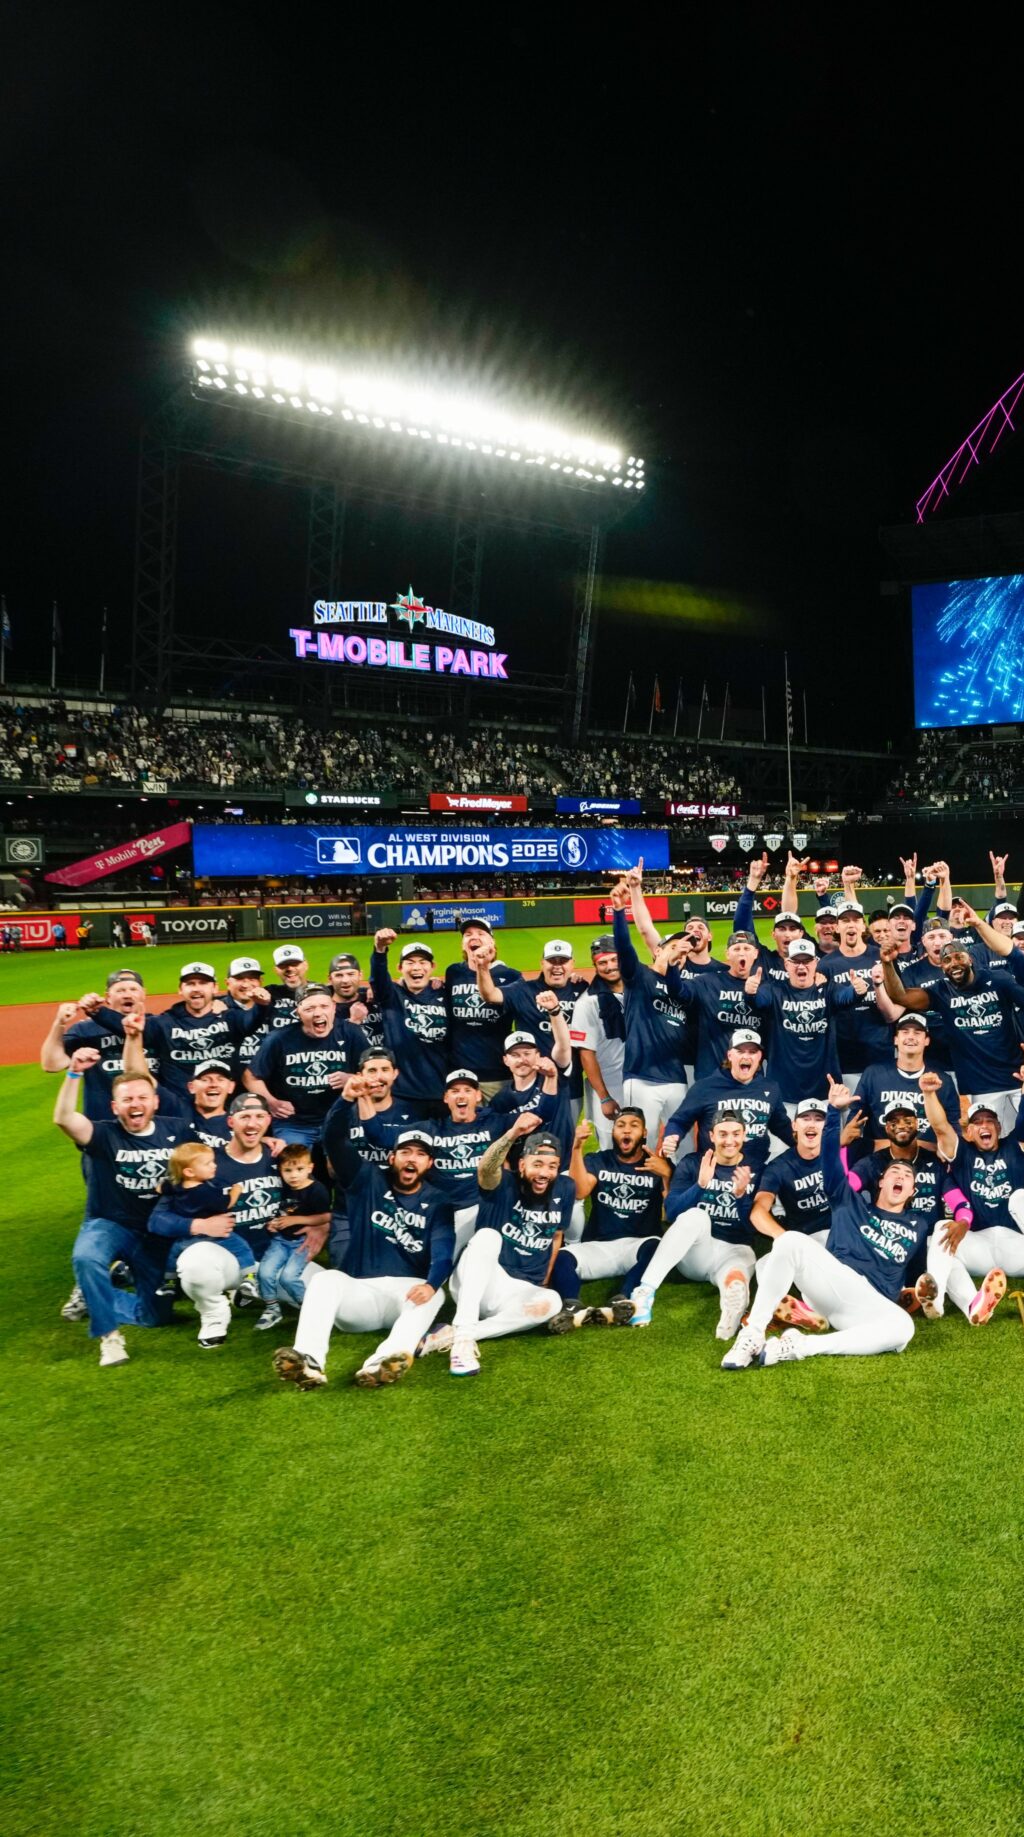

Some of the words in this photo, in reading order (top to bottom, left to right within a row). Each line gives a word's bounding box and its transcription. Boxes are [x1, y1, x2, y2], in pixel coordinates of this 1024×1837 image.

[314, 600, 387, 624] SEATTLE
[426, 606, 495, 646] MARINERS
[289, 629, 431, 671] T-MOBILE
[436, 646, 508, 678] PARK
[146, 783, 165, 792] WIN
[321, 796, 380, 804] STARBUCKS
[388, 834, 402, 842] AL
[405, 834, 437, 842] WEST
[441, 834, 489, 842] DIVISION
[368, 843, 509, 868] CHAMPIONS
[512, 844, 557, 856] 2025
[706, 901, 761, 913] KeyBk
[162, 919, 228, 932] TOYOTA
[278, 915, 323, 928] eero
[783, 999, 825, 1011] DIVISION
[951, 991, 999, 1008] DIVISION
[453, 1006, 499, 1018] CHAMPS
[718, 1011, 761, 1026] CHAMPS
[783, 1018, 828, 1032] CHAMPS
[954, 1013, 1002, 1027] CHAMPS
[285, 1051, 346, 1065] DIVISION
[718, 1099, 770, 1114] DIVISION
[434, 1131, 490, 1147] DIVISION
[599, 1170, 653, 1188] DIVISION
[598, 1192, 650, 1210] CHAMPS
[860, 1225, 907, 1262] CHAMPS
